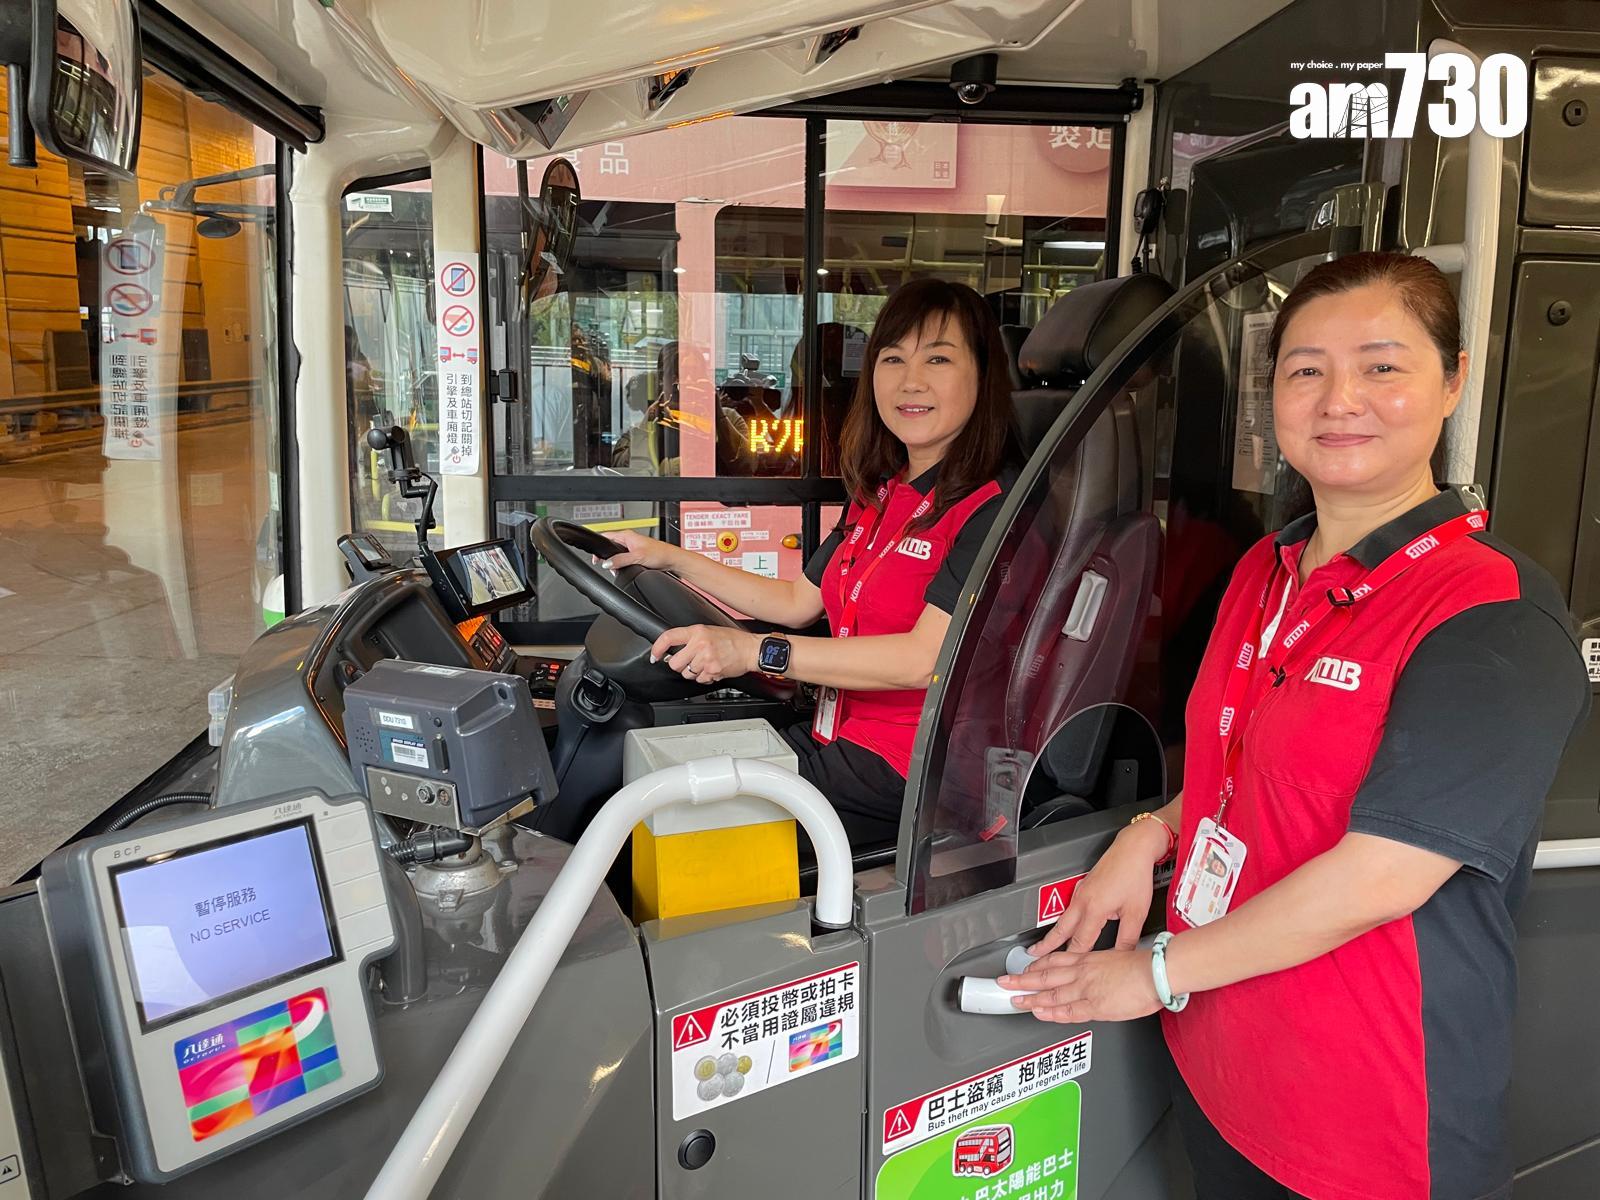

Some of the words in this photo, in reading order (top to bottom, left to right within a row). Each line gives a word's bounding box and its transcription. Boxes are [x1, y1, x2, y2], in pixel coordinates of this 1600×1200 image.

[446, 373, 458, 444] 引擎及車廂燈
[460, 374, 473, 457] 到總站切記關掉
[753, 555, 768, 570] 上
[1405, 534, 1440, 560] KMB
[1283, 620, 1310, 648] KMB
[1236, 642, 1255, 671] KMB
[1219, 706, 1235, 736] KMB
[113, 845, 142, 859] BCP
[194, 887, 257, 917] 暫停服務
[190, 928, 211, 944] NO
[214, 909, 271, 936] SERVICE
[720, 972, 855, 1029] 必須投幣或拍卡
[721, 992, 854, 1050] 不當用證屬違規
[183, 1033, 224, 1059] 八達通
[928, 1072, 1004, 1121] 巴士盜竊
[1018, 1041, 1087, 1085] 抱憾終生
[928, 1118, 946, 1132] Bus
[948, 1108, 968, 1124] theft
[971, 1101, 989, 1115] may
[991, 1091, 1016, 1106] cause
[1018, 1084, 1034, 1097] you
[1035, 1073, 1060, 1088] regret
[1061, 1067, 1074, 1077] for
[1074, 1062, 1086, 1072] life
[961, 1148, 1074, 1200] 巴太陽能巴士
